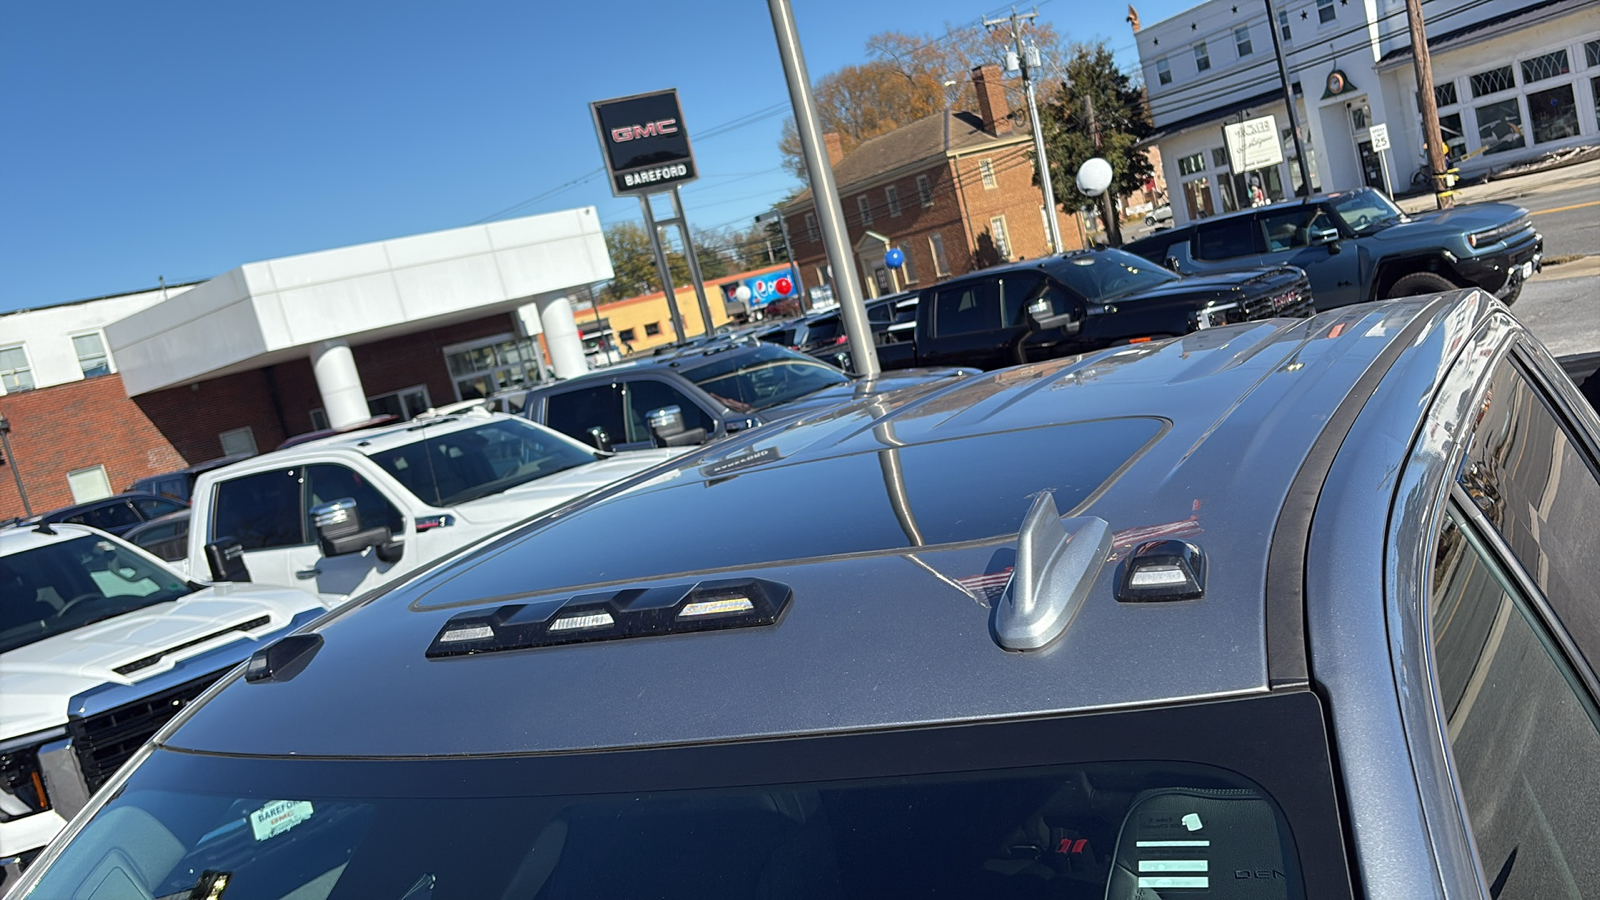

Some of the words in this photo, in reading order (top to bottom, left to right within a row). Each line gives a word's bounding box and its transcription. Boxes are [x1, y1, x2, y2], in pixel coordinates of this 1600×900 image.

[611, 118, 678, 143] GMC
[1374, 136, 1388, 149] 25
[624, 163, 687, 187] BAREFORD
[258, 801, 301, 823] BAREFOR
